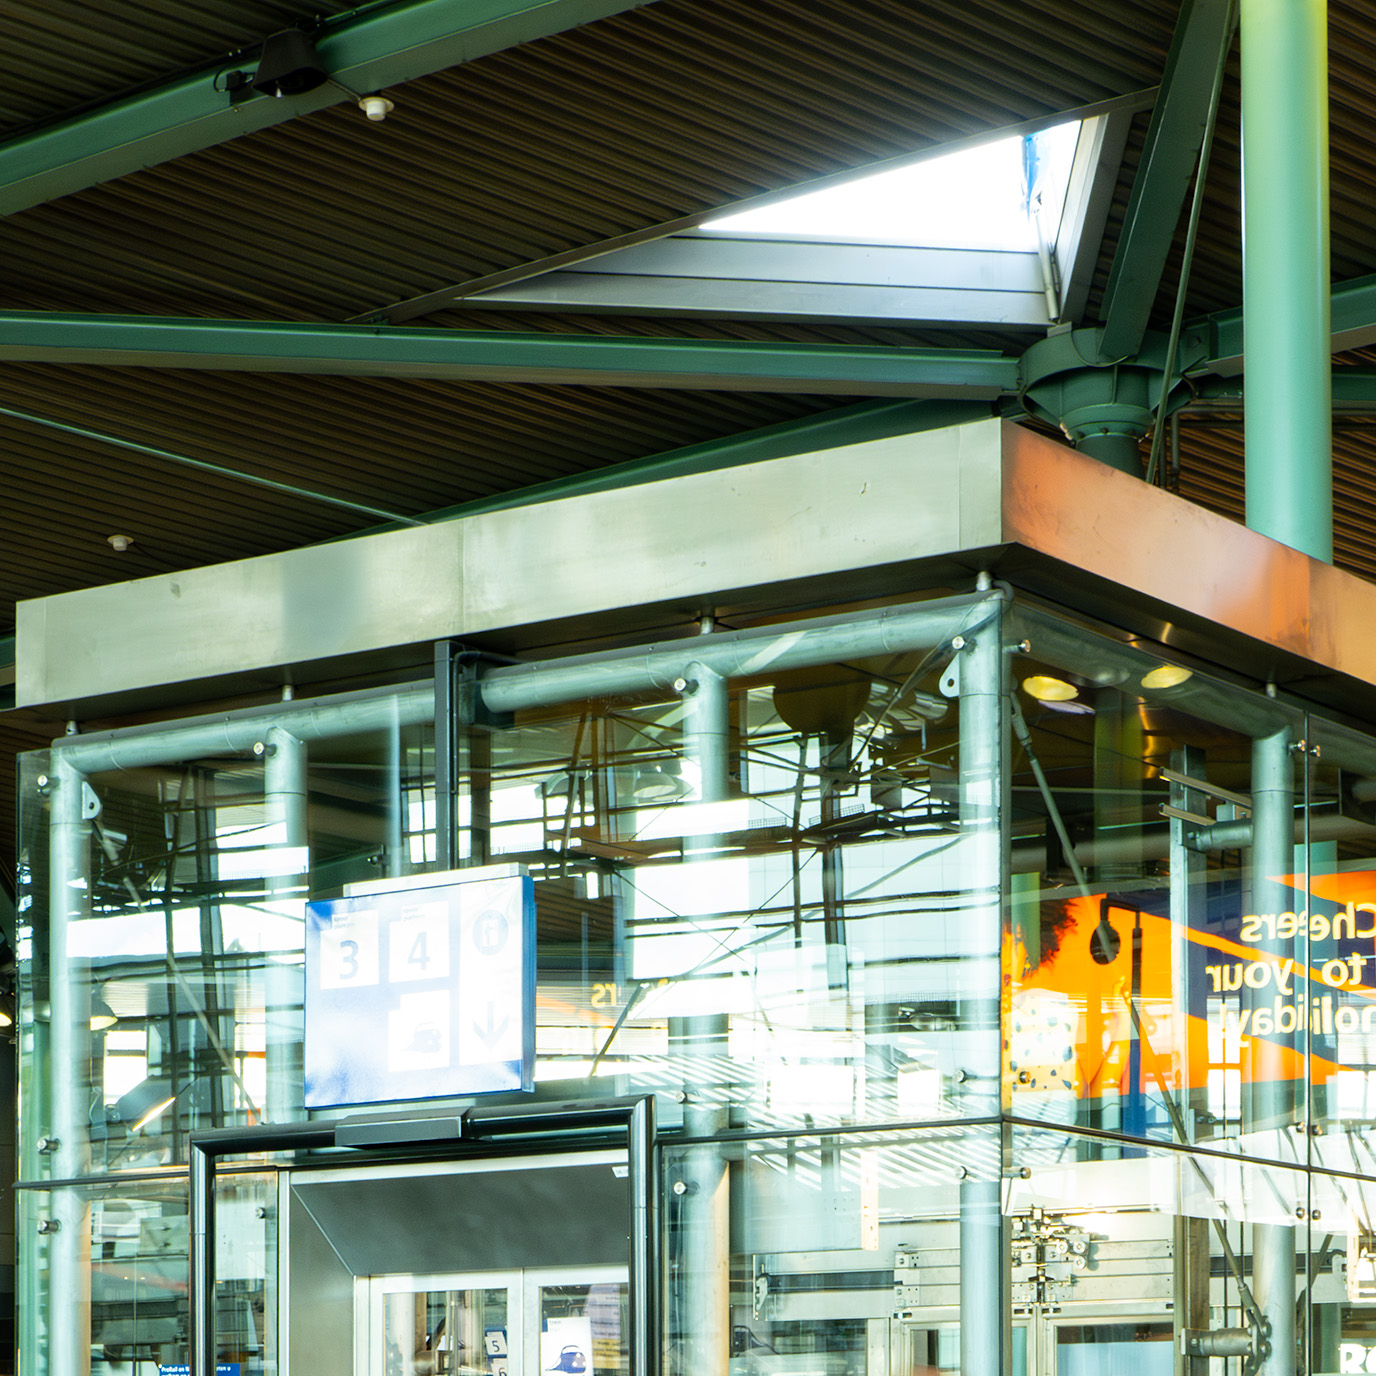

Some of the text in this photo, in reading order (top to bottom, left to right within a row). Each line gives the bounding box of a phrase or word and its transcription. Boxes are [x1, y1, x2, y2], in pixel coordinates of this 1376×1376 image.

[339, 940, 359, 980] 3
[407, 931, 430, 970] 4
[492, 1340, 500, 1352] 5
